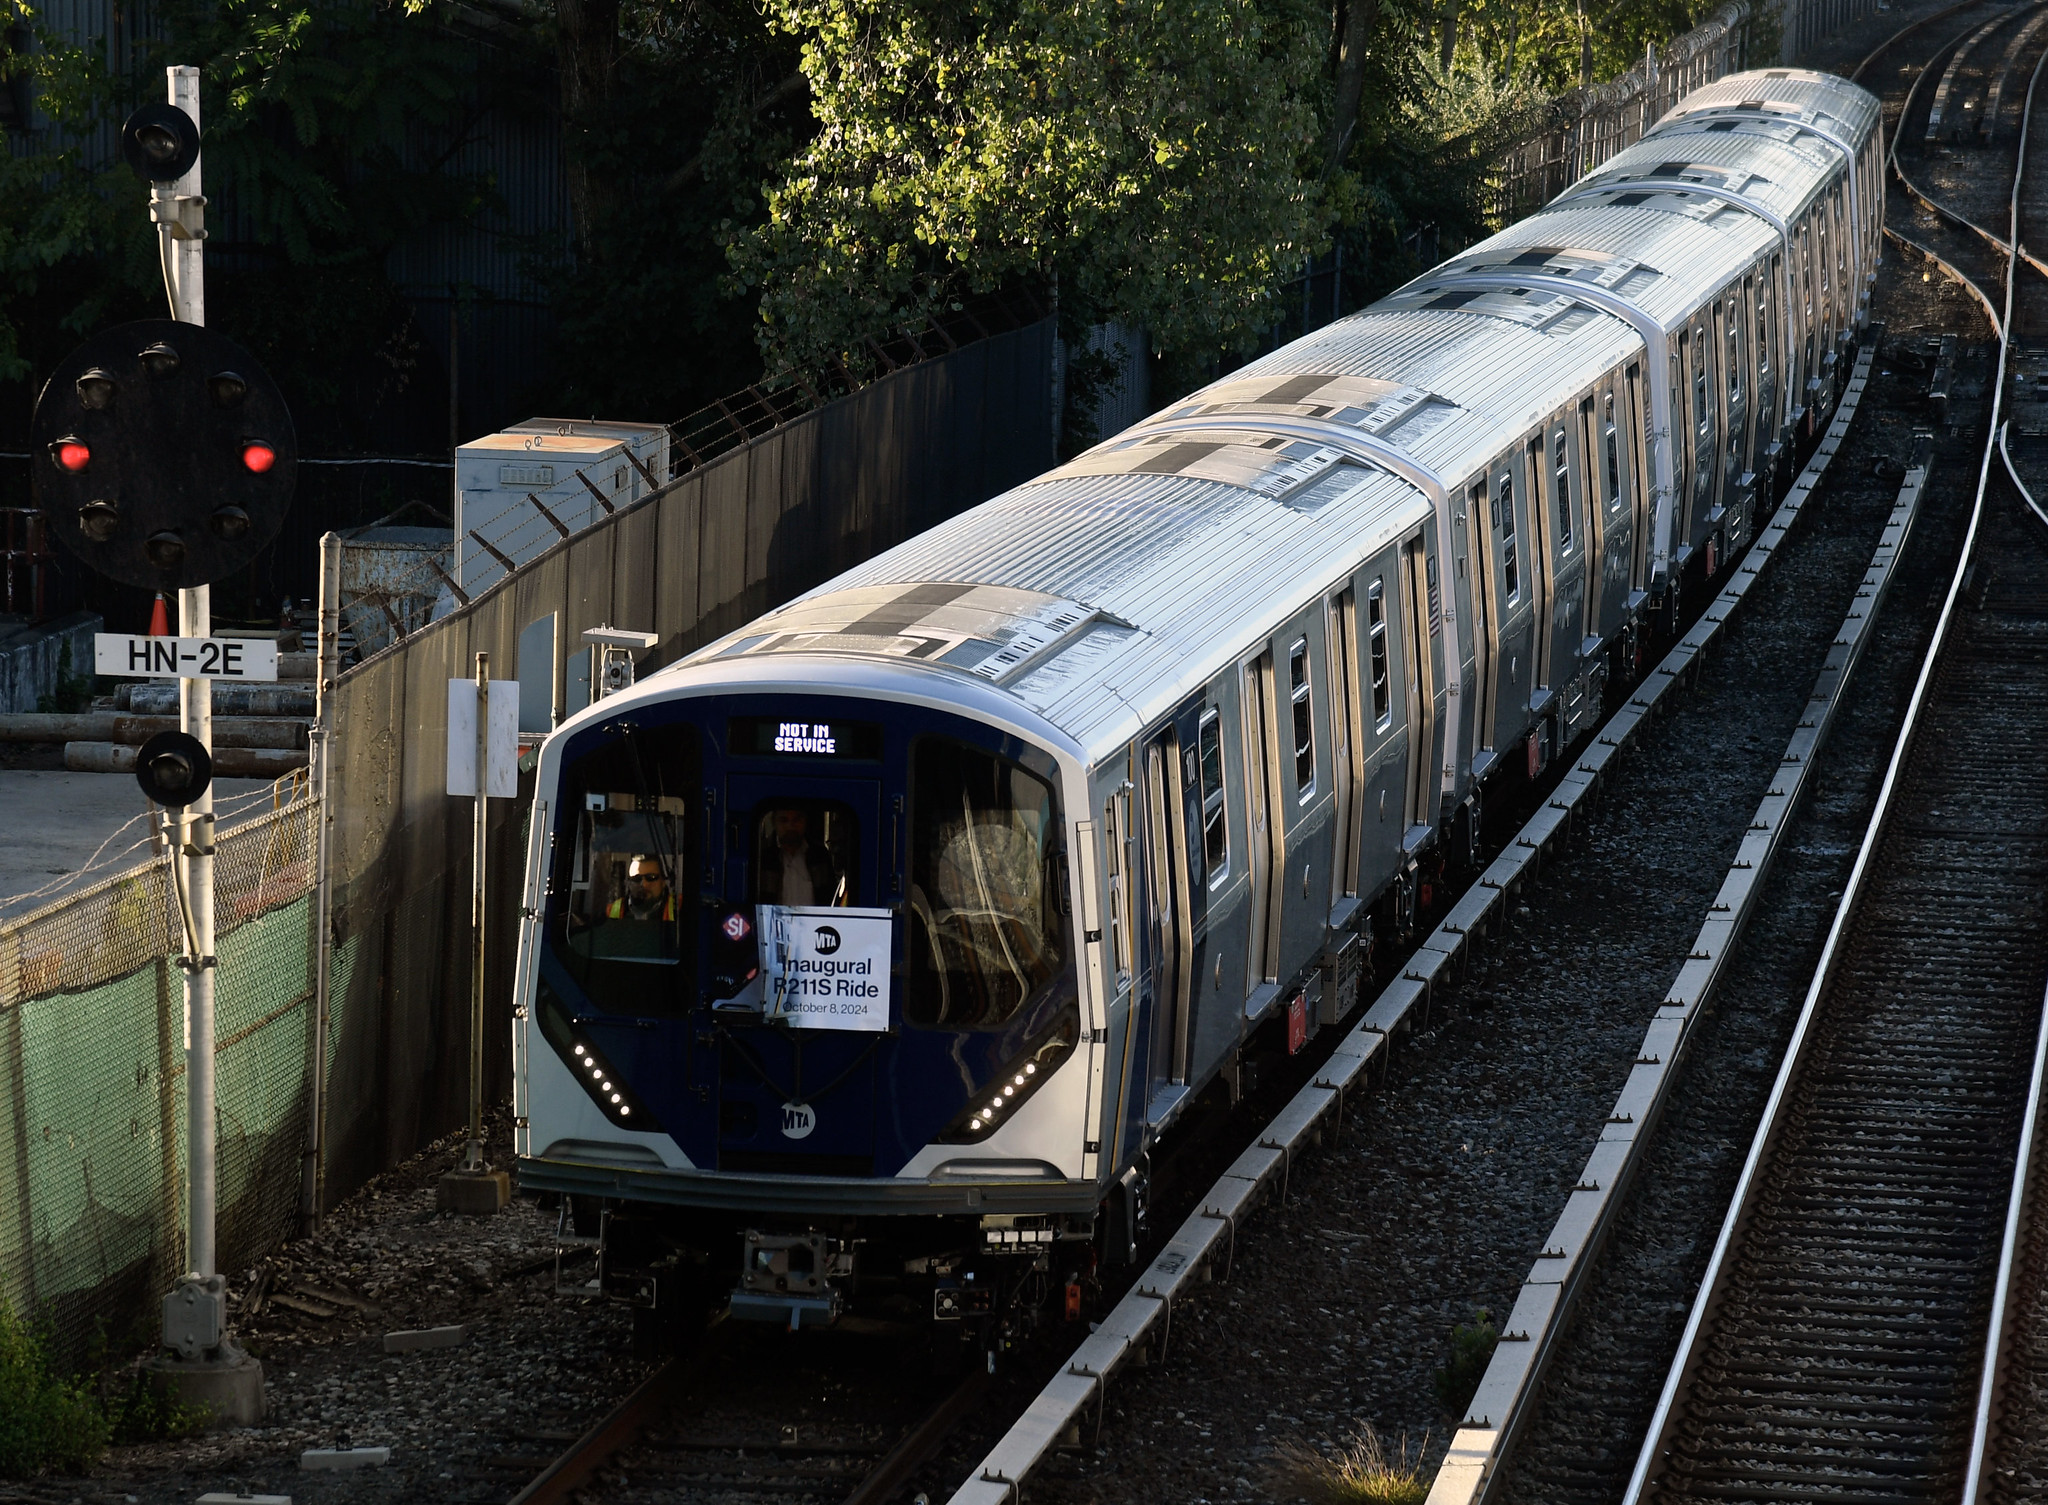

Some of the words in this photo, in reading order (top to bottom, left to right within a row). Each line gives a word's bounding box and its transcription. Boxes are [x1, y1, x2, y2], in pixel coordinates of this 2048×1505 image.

[129, 640, 243, 675] HN-2E
[779, 723, 809, 737] NOT
[813, 724, 829, 738] IN
[774, 737, 836, 753] SERVICE
[727, 917, 744, 936] SI
[814, 932, 837, 950] MTA
[782, 958, 871, 977] Inaugural
[773, 979, 831, 996] R211S
[836, 980, 879, 998] Ride
[783, 1002, 827, 1014] October
[829, 1004, 839, 1015] 8,
[841, 1004, 868, 1015] 2024
[781, 1109, 810, 1130] MTA
